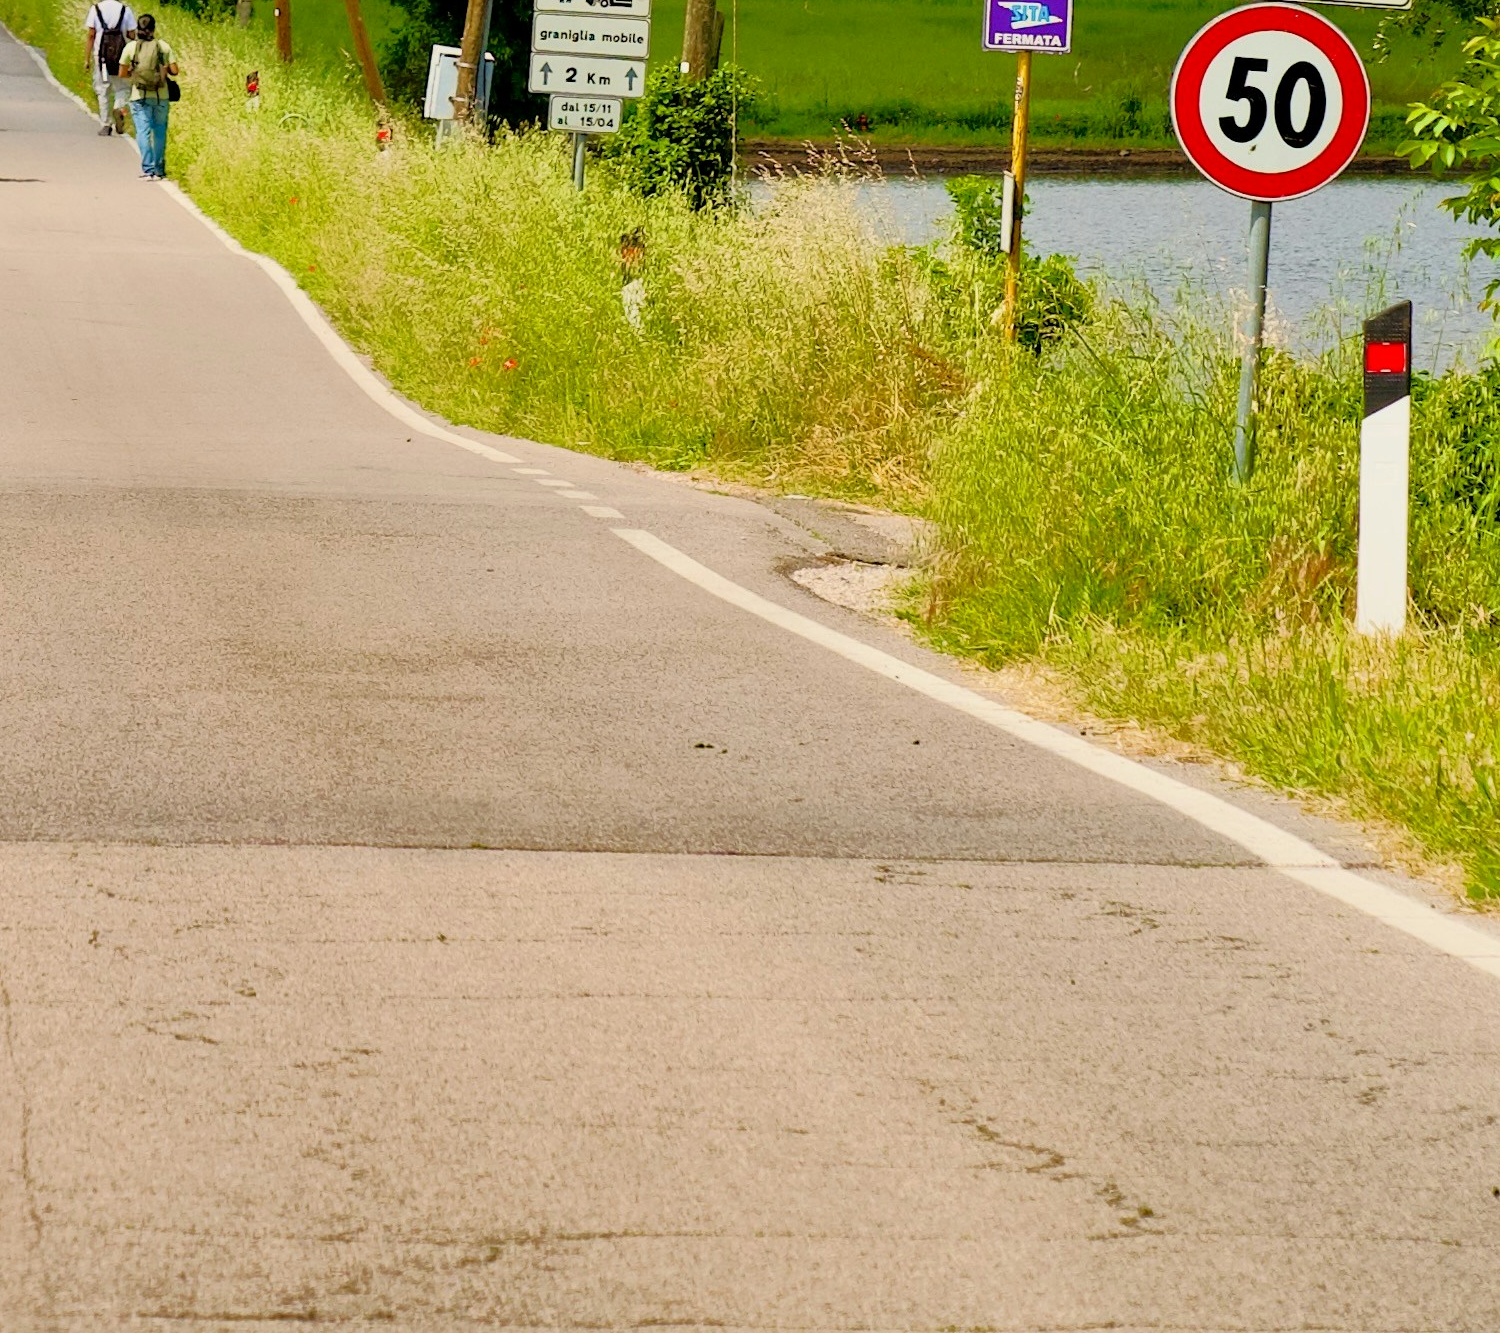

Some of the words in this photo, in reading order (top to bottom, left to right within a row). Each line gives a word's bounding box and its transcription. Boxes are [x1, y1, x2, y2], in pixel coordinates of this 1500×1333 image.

[1010, 4, 1050, 23] SITA
[540, 30, 596, 42] graniglia
[602, 33, 644, 44] mobile
[994, 32, 1062, 47] FERMATA
[565, 67, 578, 83] 2
[587, 73, 611, 85] Km
[561, 102, 579, 112] dal
[584, 103, 612, 113] 15/11
[1218, 56, 1327, 149] 50
[557, 116, 568, 125] al
[580, 116, 614, 128] 15/04
